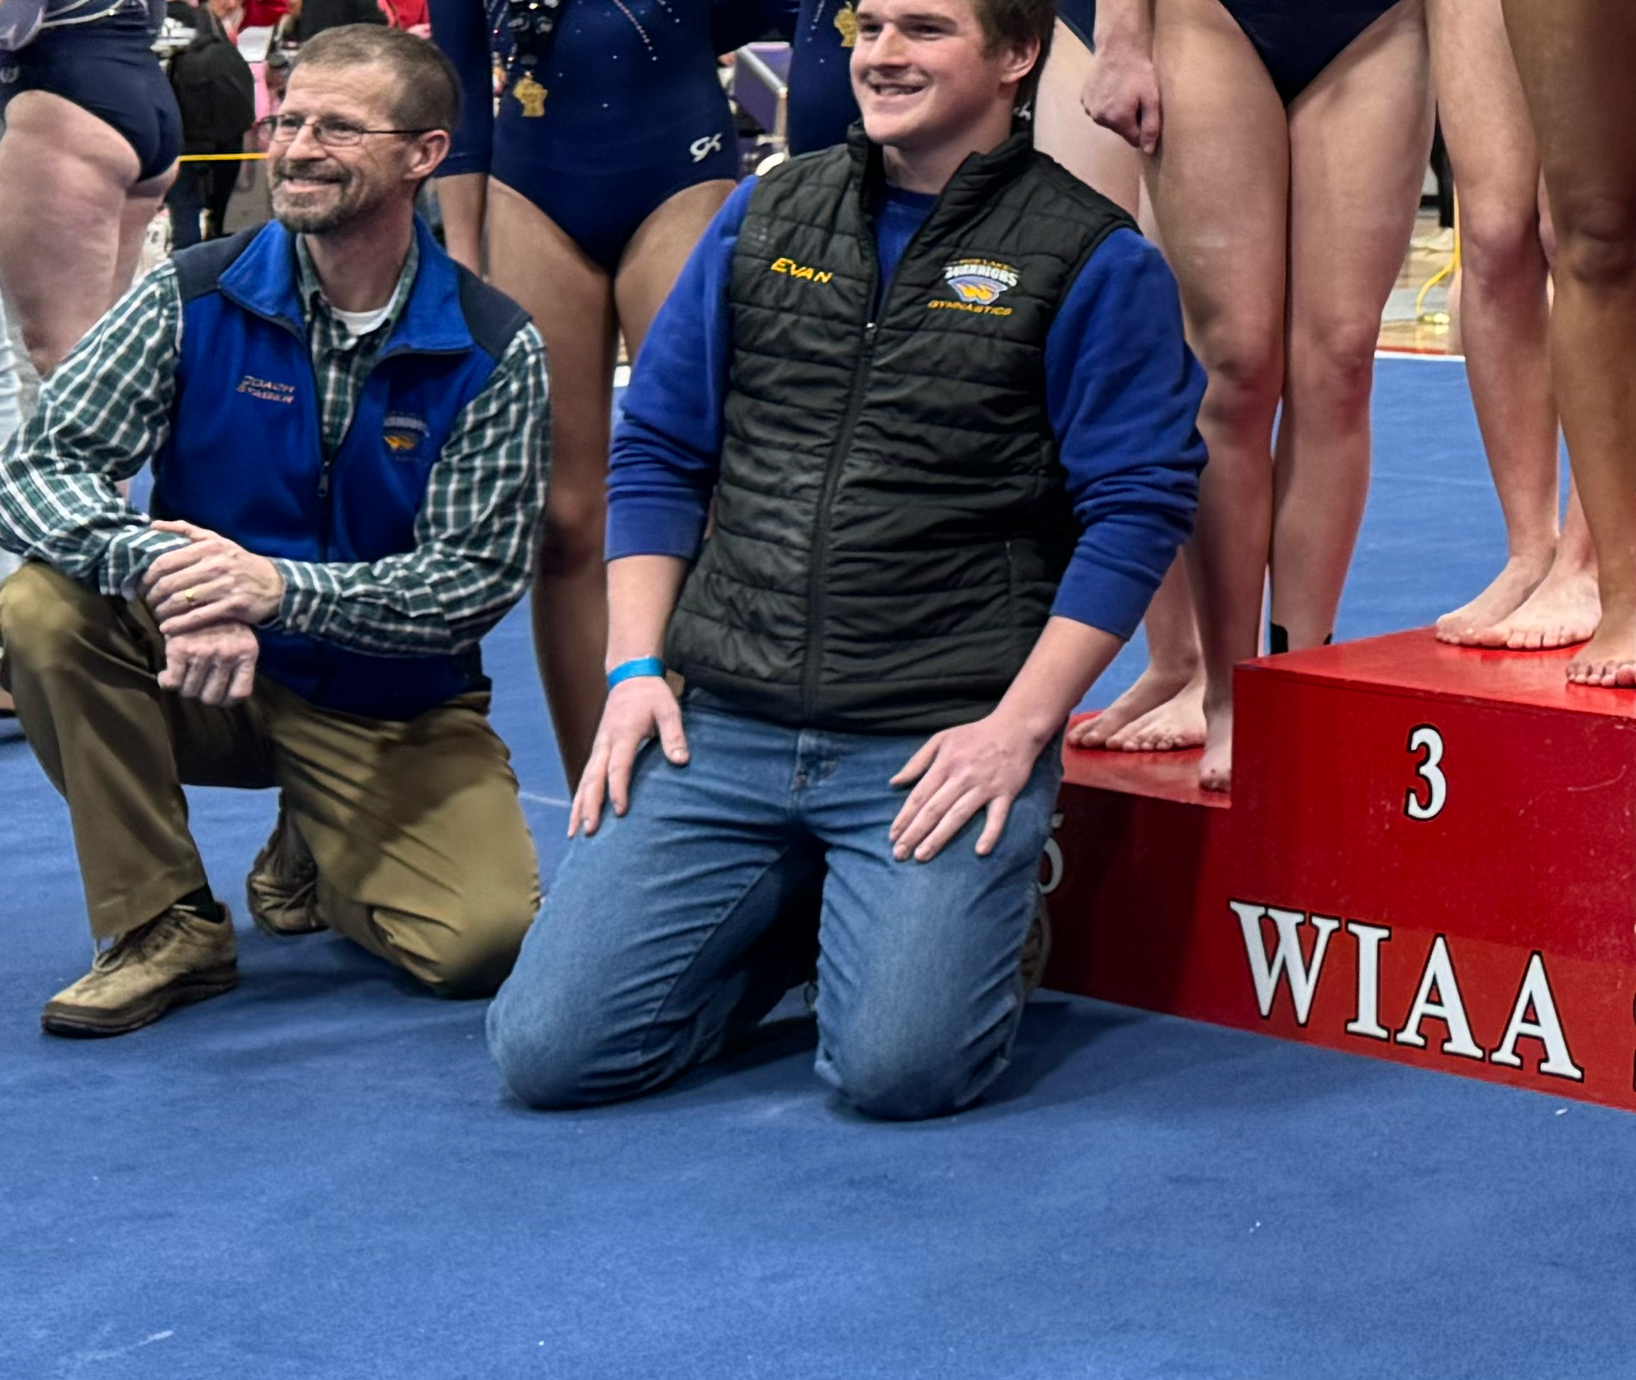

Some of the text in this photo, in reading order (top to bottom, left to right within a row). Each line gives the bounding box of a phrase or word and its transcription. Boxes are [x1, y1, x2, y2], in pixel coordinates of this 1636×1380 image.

[770, 256, 834, 285] EVAN
[1405, 724, 1448, 820] 3
[1229, 898, 1583, 1082] WIAA
